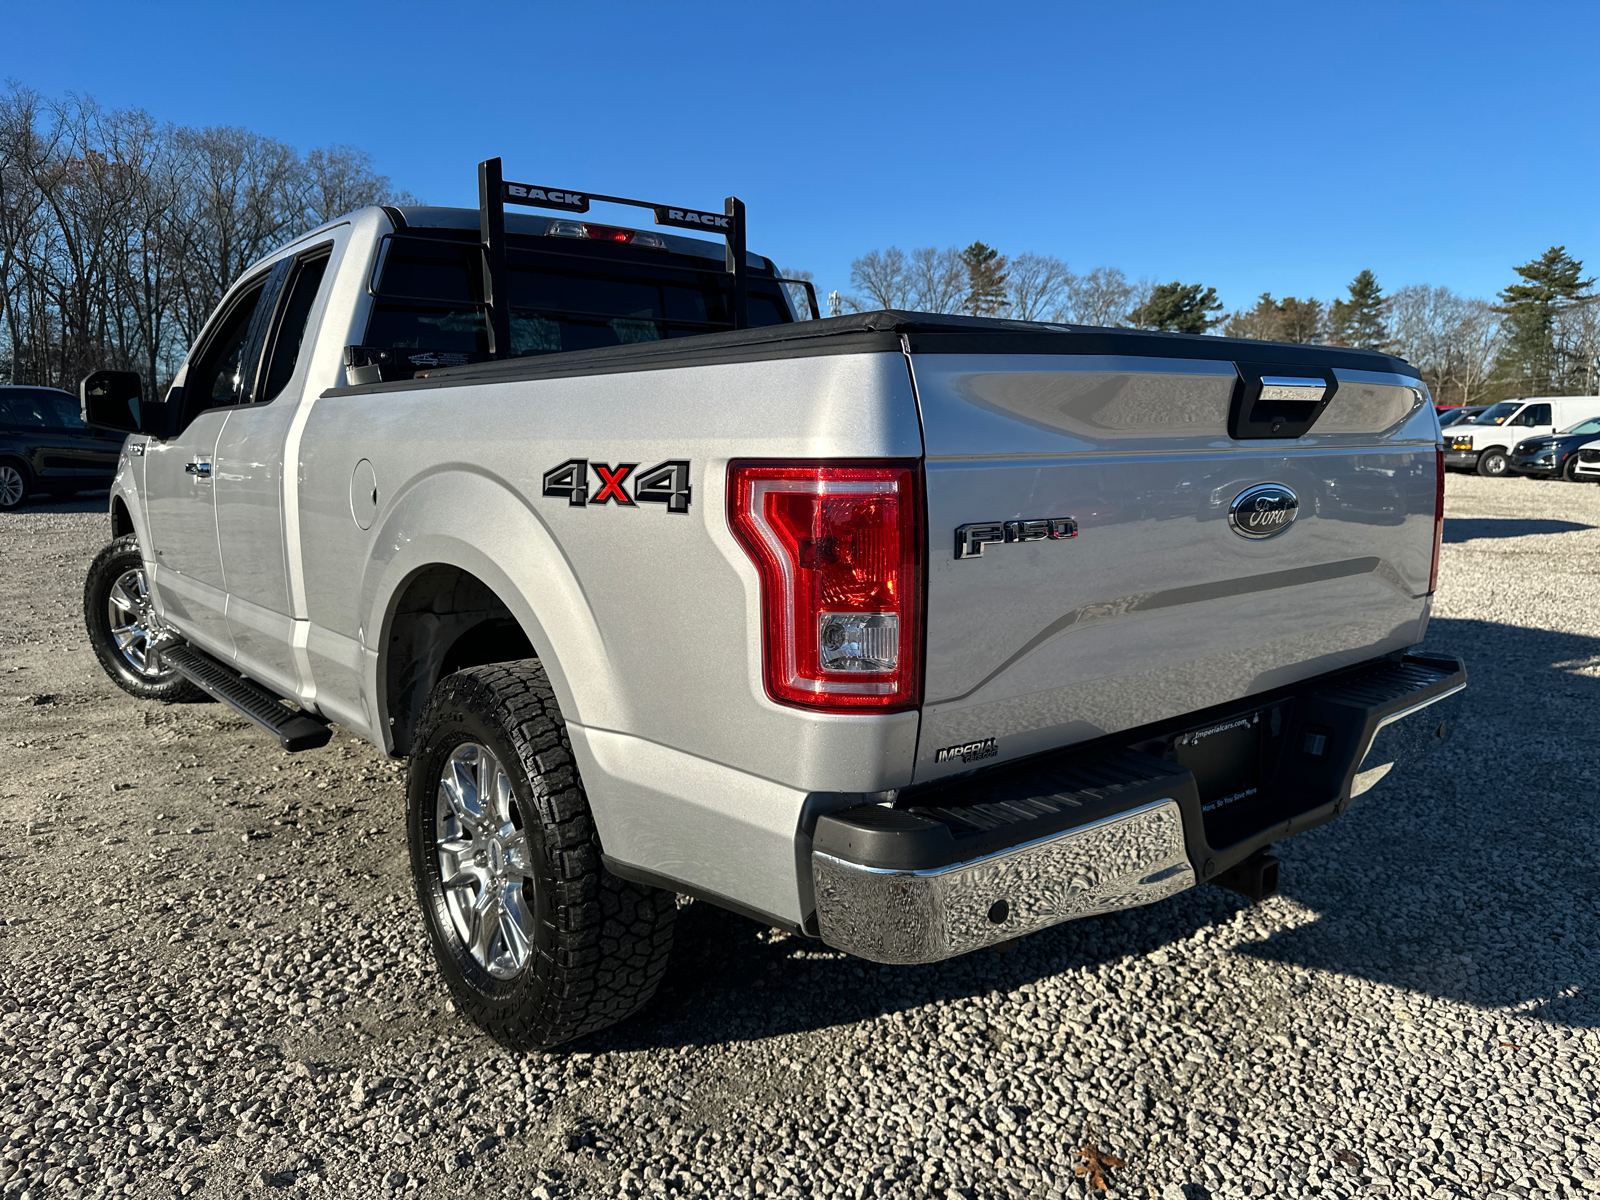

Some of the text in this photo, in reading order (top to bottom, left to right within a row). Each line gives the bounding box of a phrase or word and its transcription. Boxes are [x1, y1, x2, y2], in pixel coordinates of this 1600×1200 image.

[508, 184, 731, 228] BACK RACK
[1249, 496, 1288, 527] Ford
[1194, 718, 1247, 739] Imperialcars.com
[935, 737, 999, 763] IMPERIAL
[1216, 799, 1224, 808] So
[1223, 796, 1234, 804] You
[1233, 791, 1245, 801] Save
[1245, 787, 1258, 797] More
